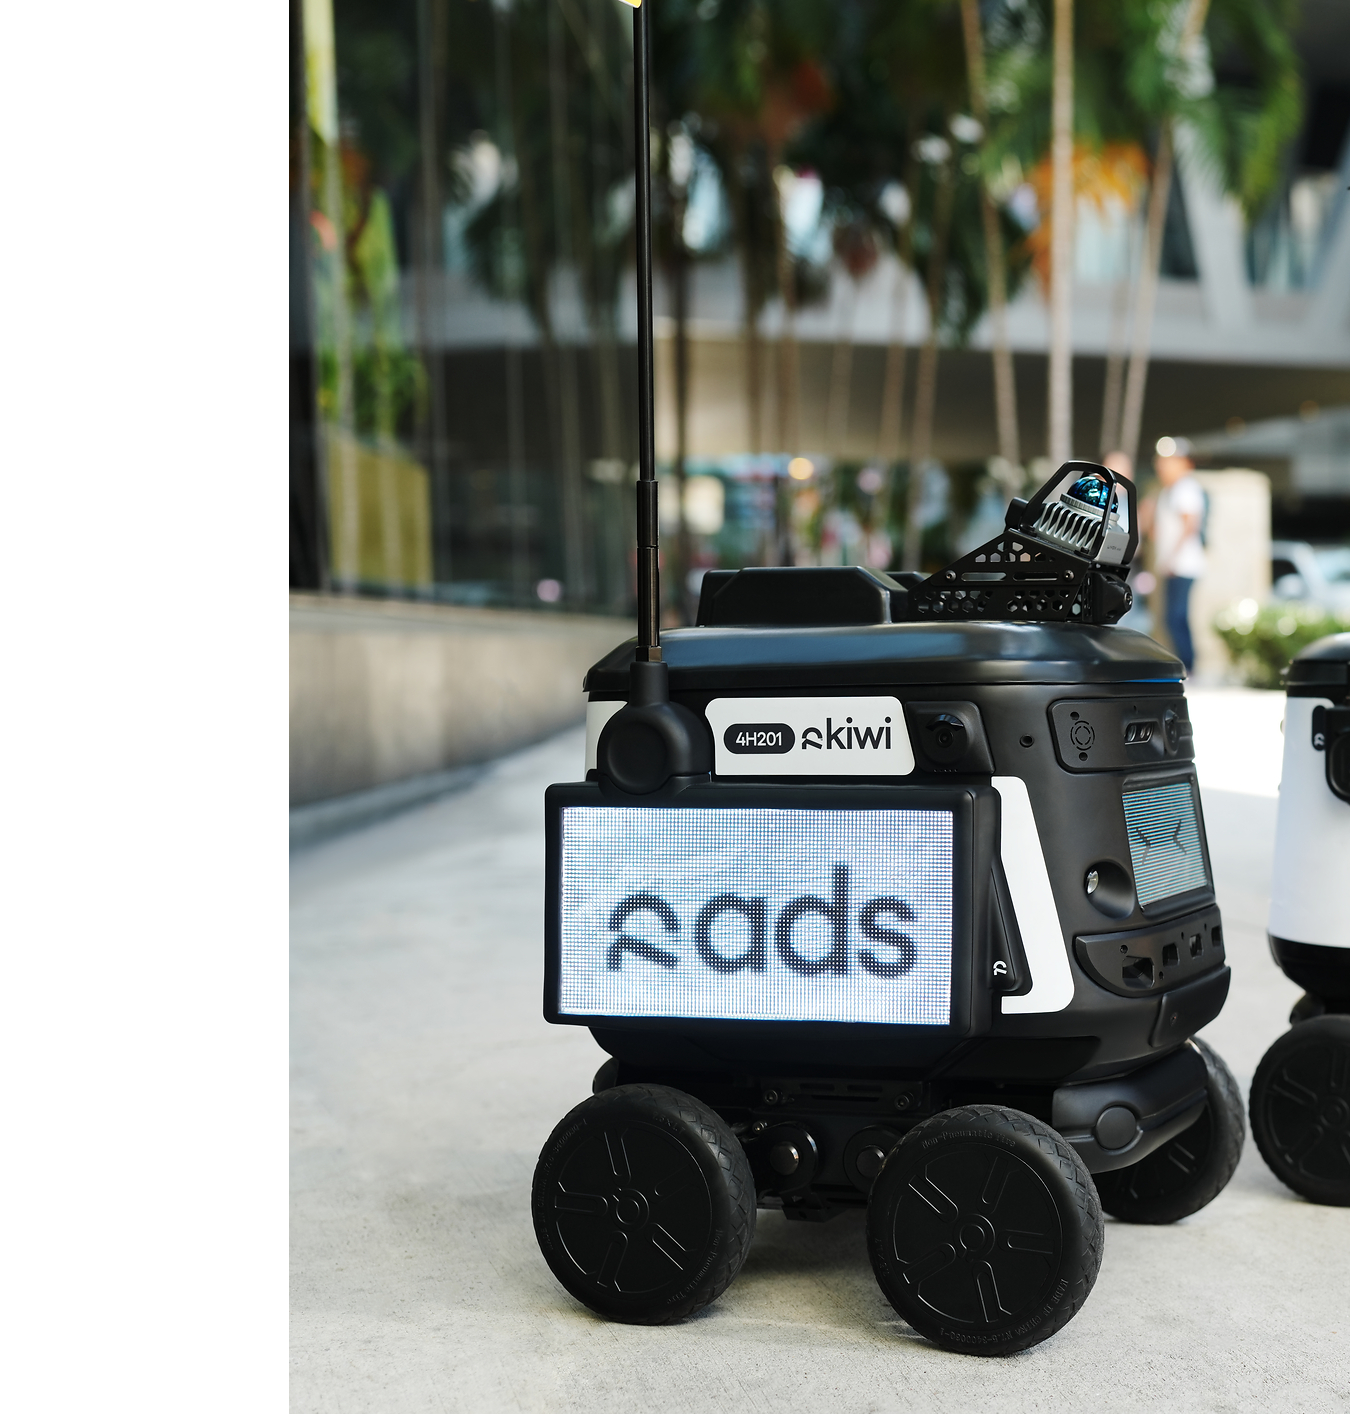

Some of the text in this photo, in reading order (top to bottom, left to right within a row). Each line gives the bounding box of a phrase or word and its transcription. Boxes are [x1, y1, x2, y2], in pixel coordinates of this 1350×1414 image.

[735, 731, 782, 747] 4H201
[695, 864, 918, 977] ads
[921, 1129, 1016, 1149] Non-Pneumatic Tire
[1049, 1278, 1069, 1305] MADE
[1041, 1303, 1054, 1317] IN
[1014, 1315, 1042, 1337] CHINA
